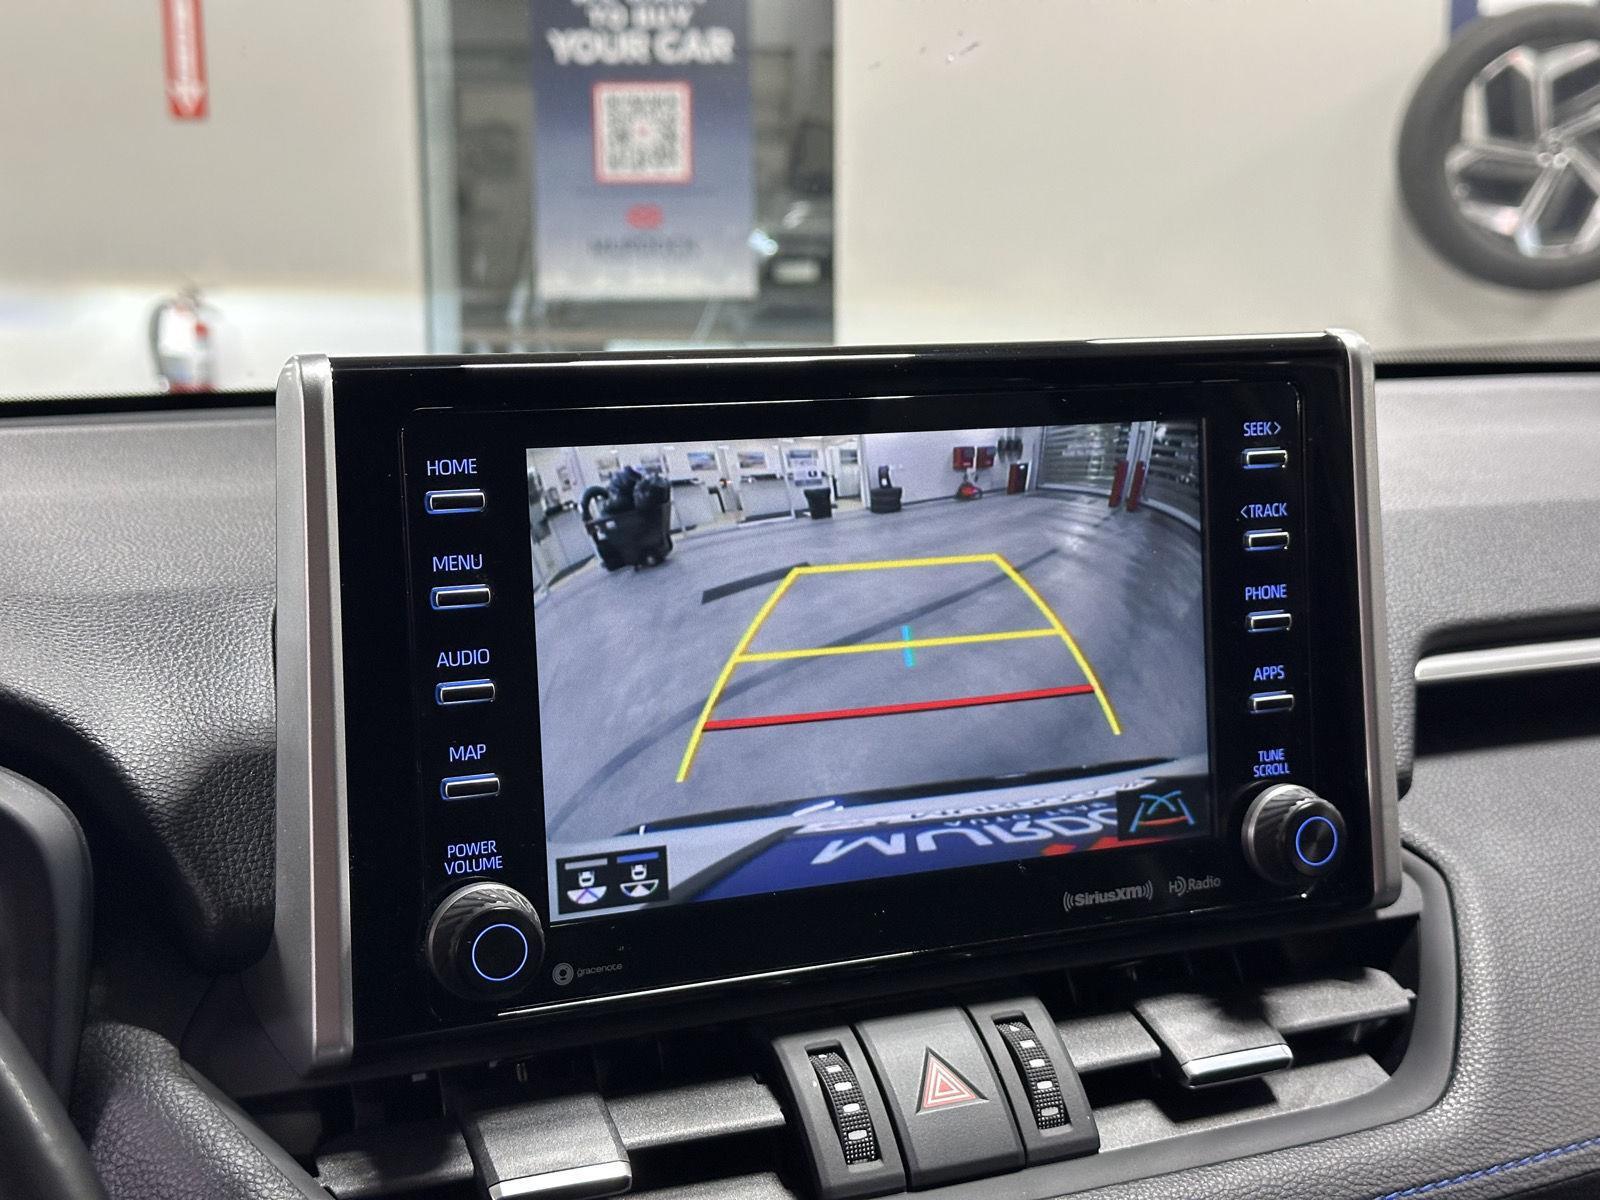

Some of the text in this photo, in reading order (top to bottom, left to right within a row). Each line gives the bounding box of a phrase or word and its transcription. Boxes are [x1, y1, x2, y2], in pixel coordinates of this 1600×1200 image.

[546, 26, 735, 65] YOUR CAR
[426, 458, 478, 476] HOME
[432, 554, 483, 572] MENU
[1245, 584, 1288, 600] PHONE
[436, 648, 490, 668] AUDIO
[1253, 665, 1285, 681] APPS
[449, 743, 487, 762] MAP
[1258, 748, 1285, 762] TUNE
[1253, 762, 1290, 777] SCROLL
[447, 840, 497, 859] POWER
[444, 855, 503, 876] VOLUME
[1188, 875, 1221, 891] Radio
[576, 963, 623, 978] gracenote
